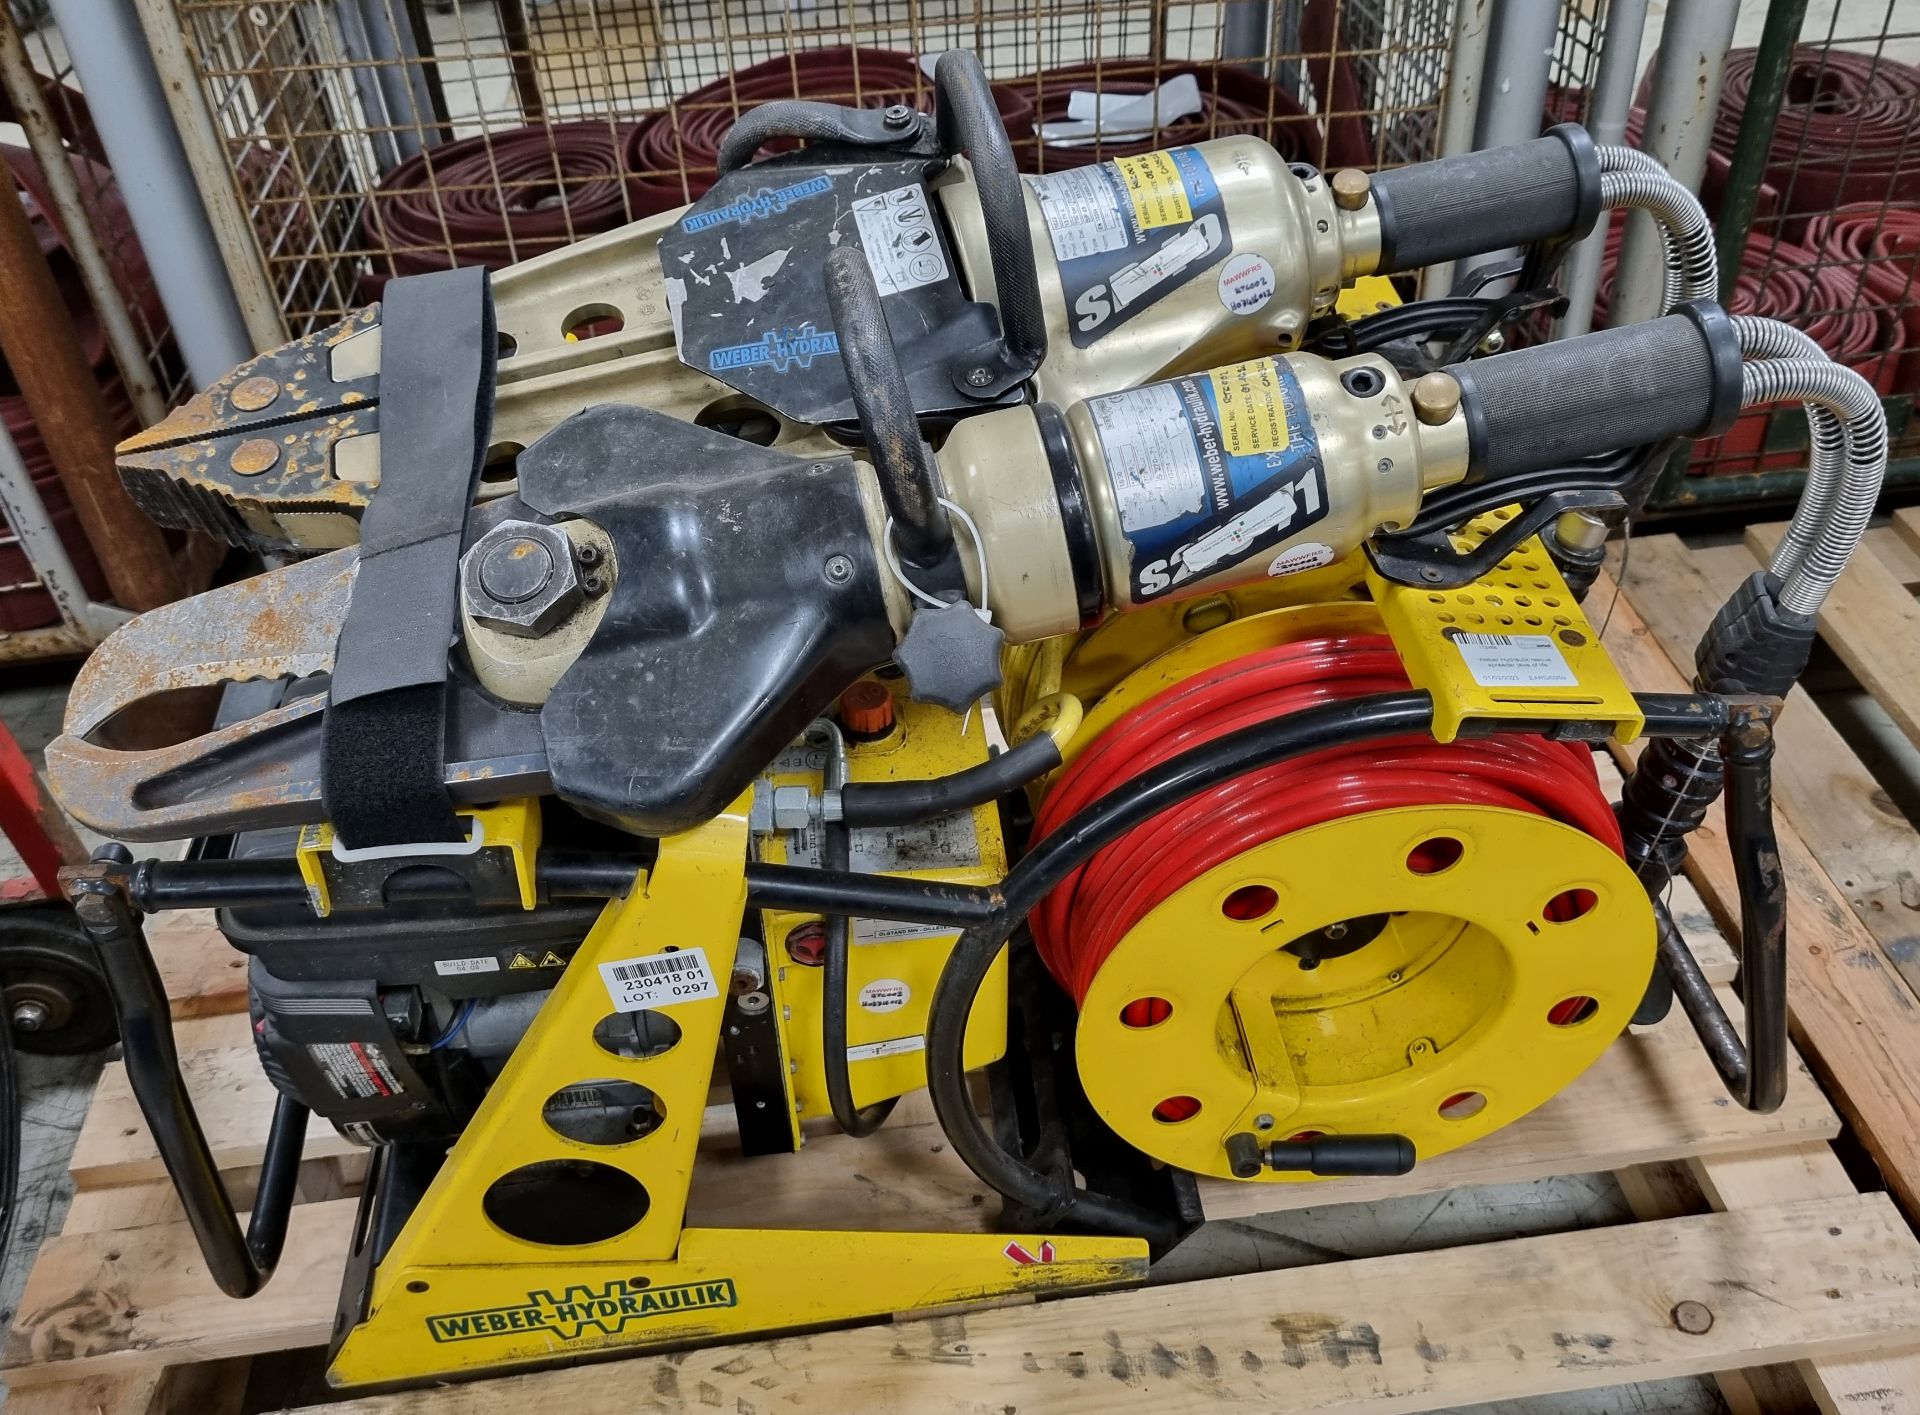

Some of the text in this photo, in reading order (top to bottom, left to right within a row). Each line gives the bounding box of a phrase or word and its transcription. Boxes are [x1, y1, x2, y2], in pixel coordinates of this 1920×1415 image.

[686, 178, 830, 231] WEBER-HYDRAULIK
[1223, 263, 1262, 287] MAWWFRS
[714, 333, 839, 366] WEBER-HYDRA
[1183, 380, 1231, 511] www.weber-hydraulik.com
[1230, 421, 1240, 452] SERIAL
[1248, 416, 1260, 450] SERVICE
[622, 982, 710, 1004] LOT: 0297
[624, 969, 706, 991] 230418 01
[436, 1283, 729, 1337] WEBER-HYDRAULIK
